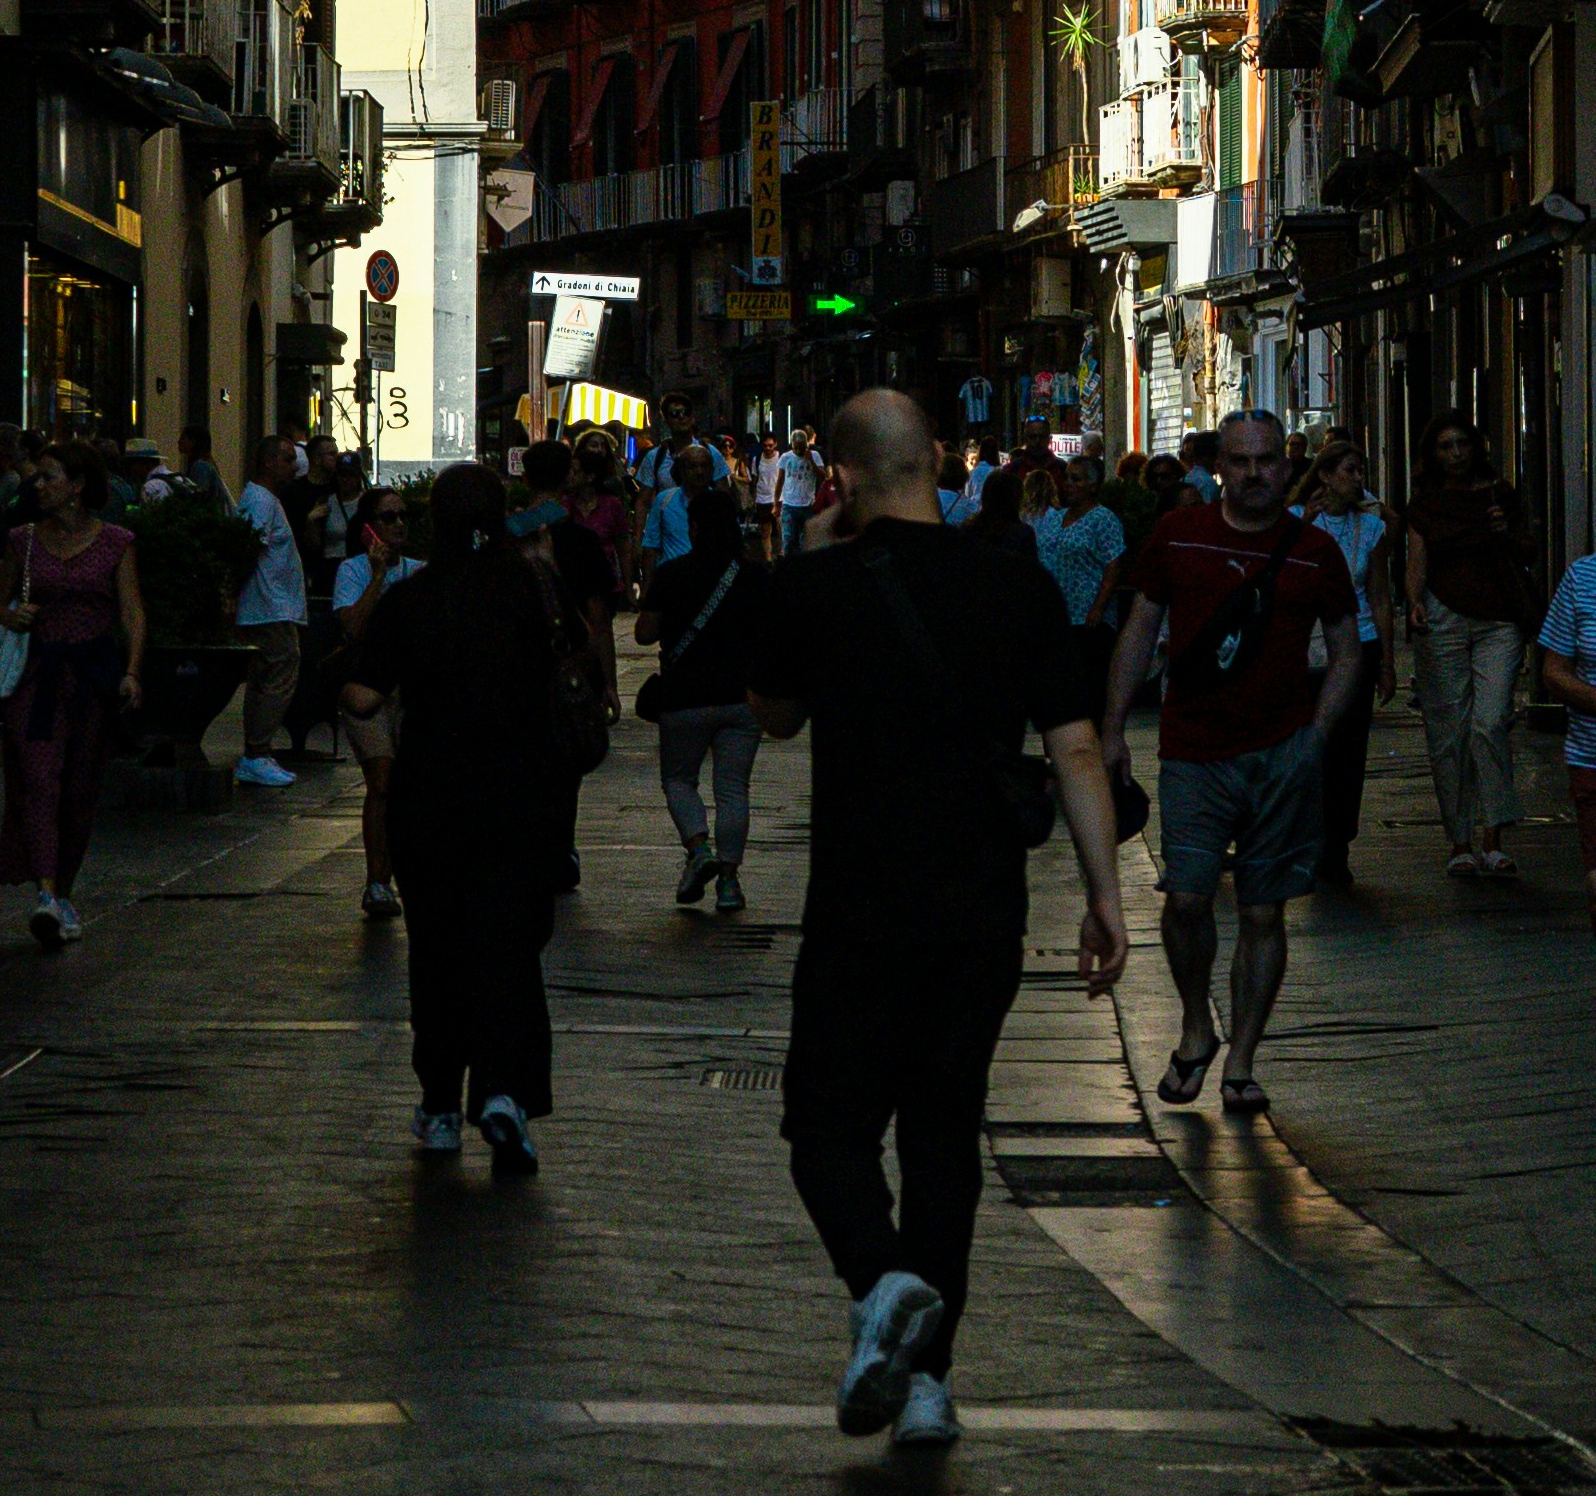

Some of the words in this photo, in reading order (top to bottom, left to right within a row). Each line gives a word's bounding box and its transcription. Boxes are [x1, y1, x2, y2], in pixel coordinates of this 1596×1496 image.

[756, 105, 776, 255] BRANDI
[557, 279, 591, 291] Gradoni
[594, 281, 604, 292] di
[607, 282, 635, 294] Chiaia
[731, 294, 790, 309] PIZZERIA
[556, 326, 595, 338] attenzione
[374, 360, 389, 369] TAXI
[971, 385, 982, 399] 10
